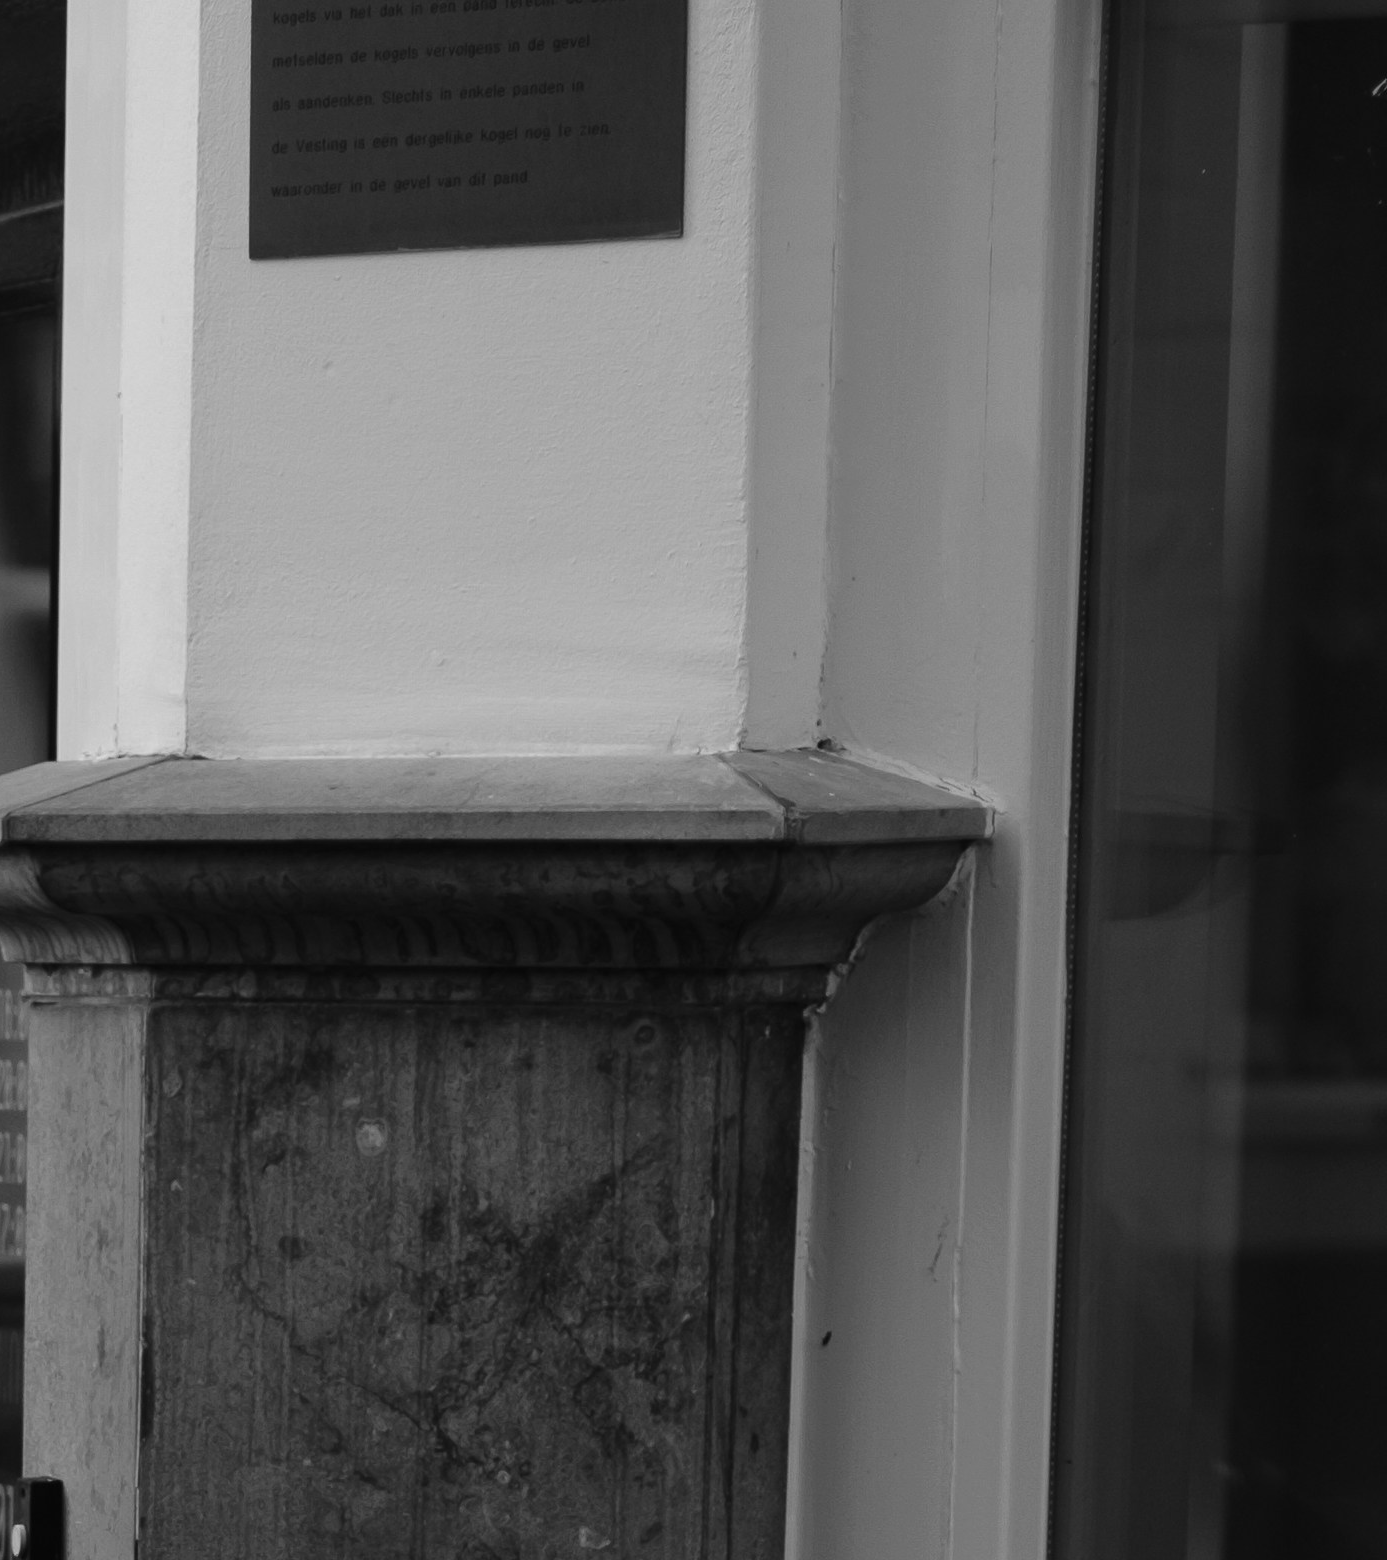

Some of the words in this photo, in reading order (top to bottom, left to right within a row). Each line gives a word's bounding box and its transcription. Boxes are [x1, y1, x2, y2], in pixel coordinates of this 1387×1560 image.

[273, 9, 317, 27] kogels
[324, 7, 342, 21] via
[350, 5, 371, 20] het
[380, 3, 403, 18] dak
[411, 2, 423, 16] in
[430, 1, 456, 14] een
[272, 51, 343, 68] metselden
[350, 50, 367, 63] de
[374, 46, 418, 63] kogels
[425, 42, 501, 59] vervolgens
[508, 39, 520, 52] in
[528, 38, 545, 52] de
[552, 34, 591, 53] gevel
[272, 97, 291, 112] als
[382, 89, 433, 104] Slechts
[440, 87, 452, 100] in
[460, 84, 505, 99] enkele
[513, 81, 564, 98] panden
[572, 80, 585, 93] in
[272, 140, 289, 154] de
[295, 137, 348, 153] Vesting
[354, 137, 365, 150] is
[372, 135, 398, 148] een
[405, 129, 473, 148] dergelijke
[481, 127, 518, 144] kogel
[525, 127, 550, 141] nog
[558, 123, 572, 138] te
[271, 181, 343, 198] waaronder
[350, 180, 362, 193] in
[370, 179, 386, 192] de
[394, 175, 430, 194] gevel
[438, 175, 461, 188] van
[469, 172, 486, 186] dit
